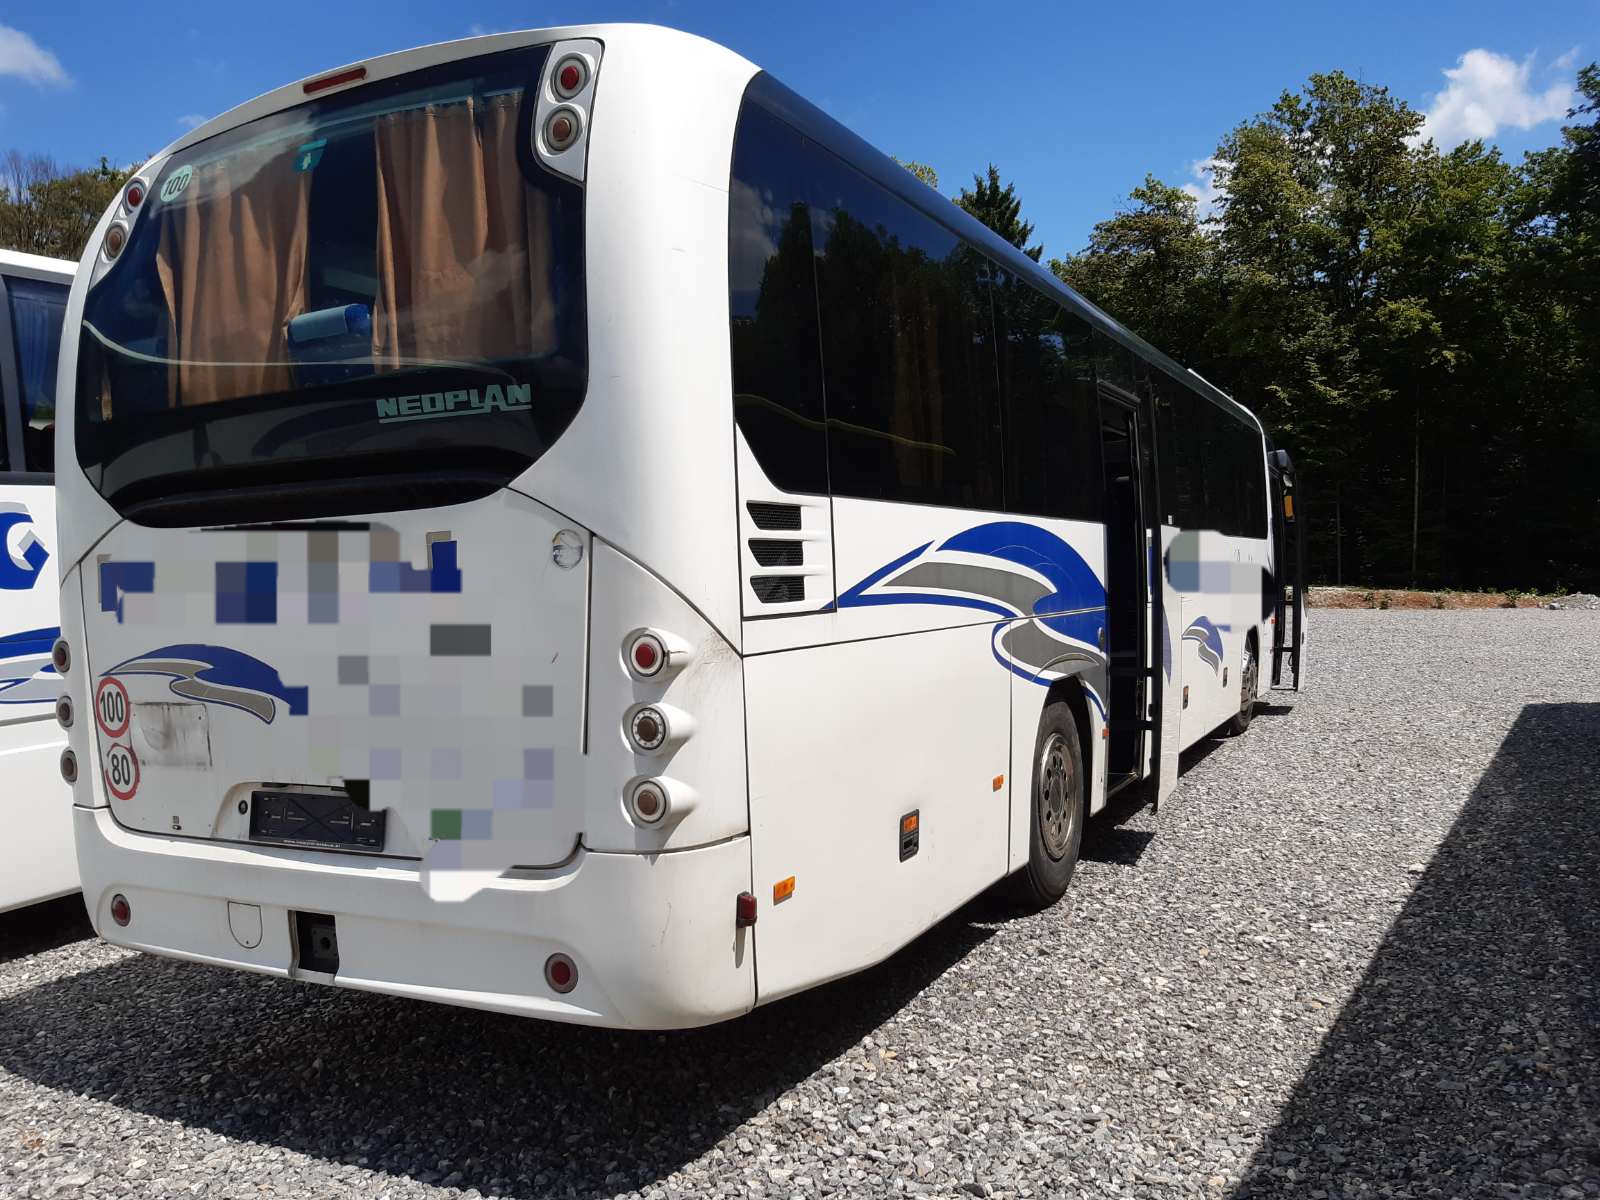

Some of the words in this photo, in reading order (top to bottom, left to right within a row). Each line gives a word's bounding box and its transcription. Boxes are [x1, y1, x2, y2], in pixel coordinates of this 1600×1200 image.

[163, 173, 190, 198] 100
[376, 384, 532, 419] NEOPLAN
[100, 691, 124, 723] 100
[111, 753, 131, 786] 80
